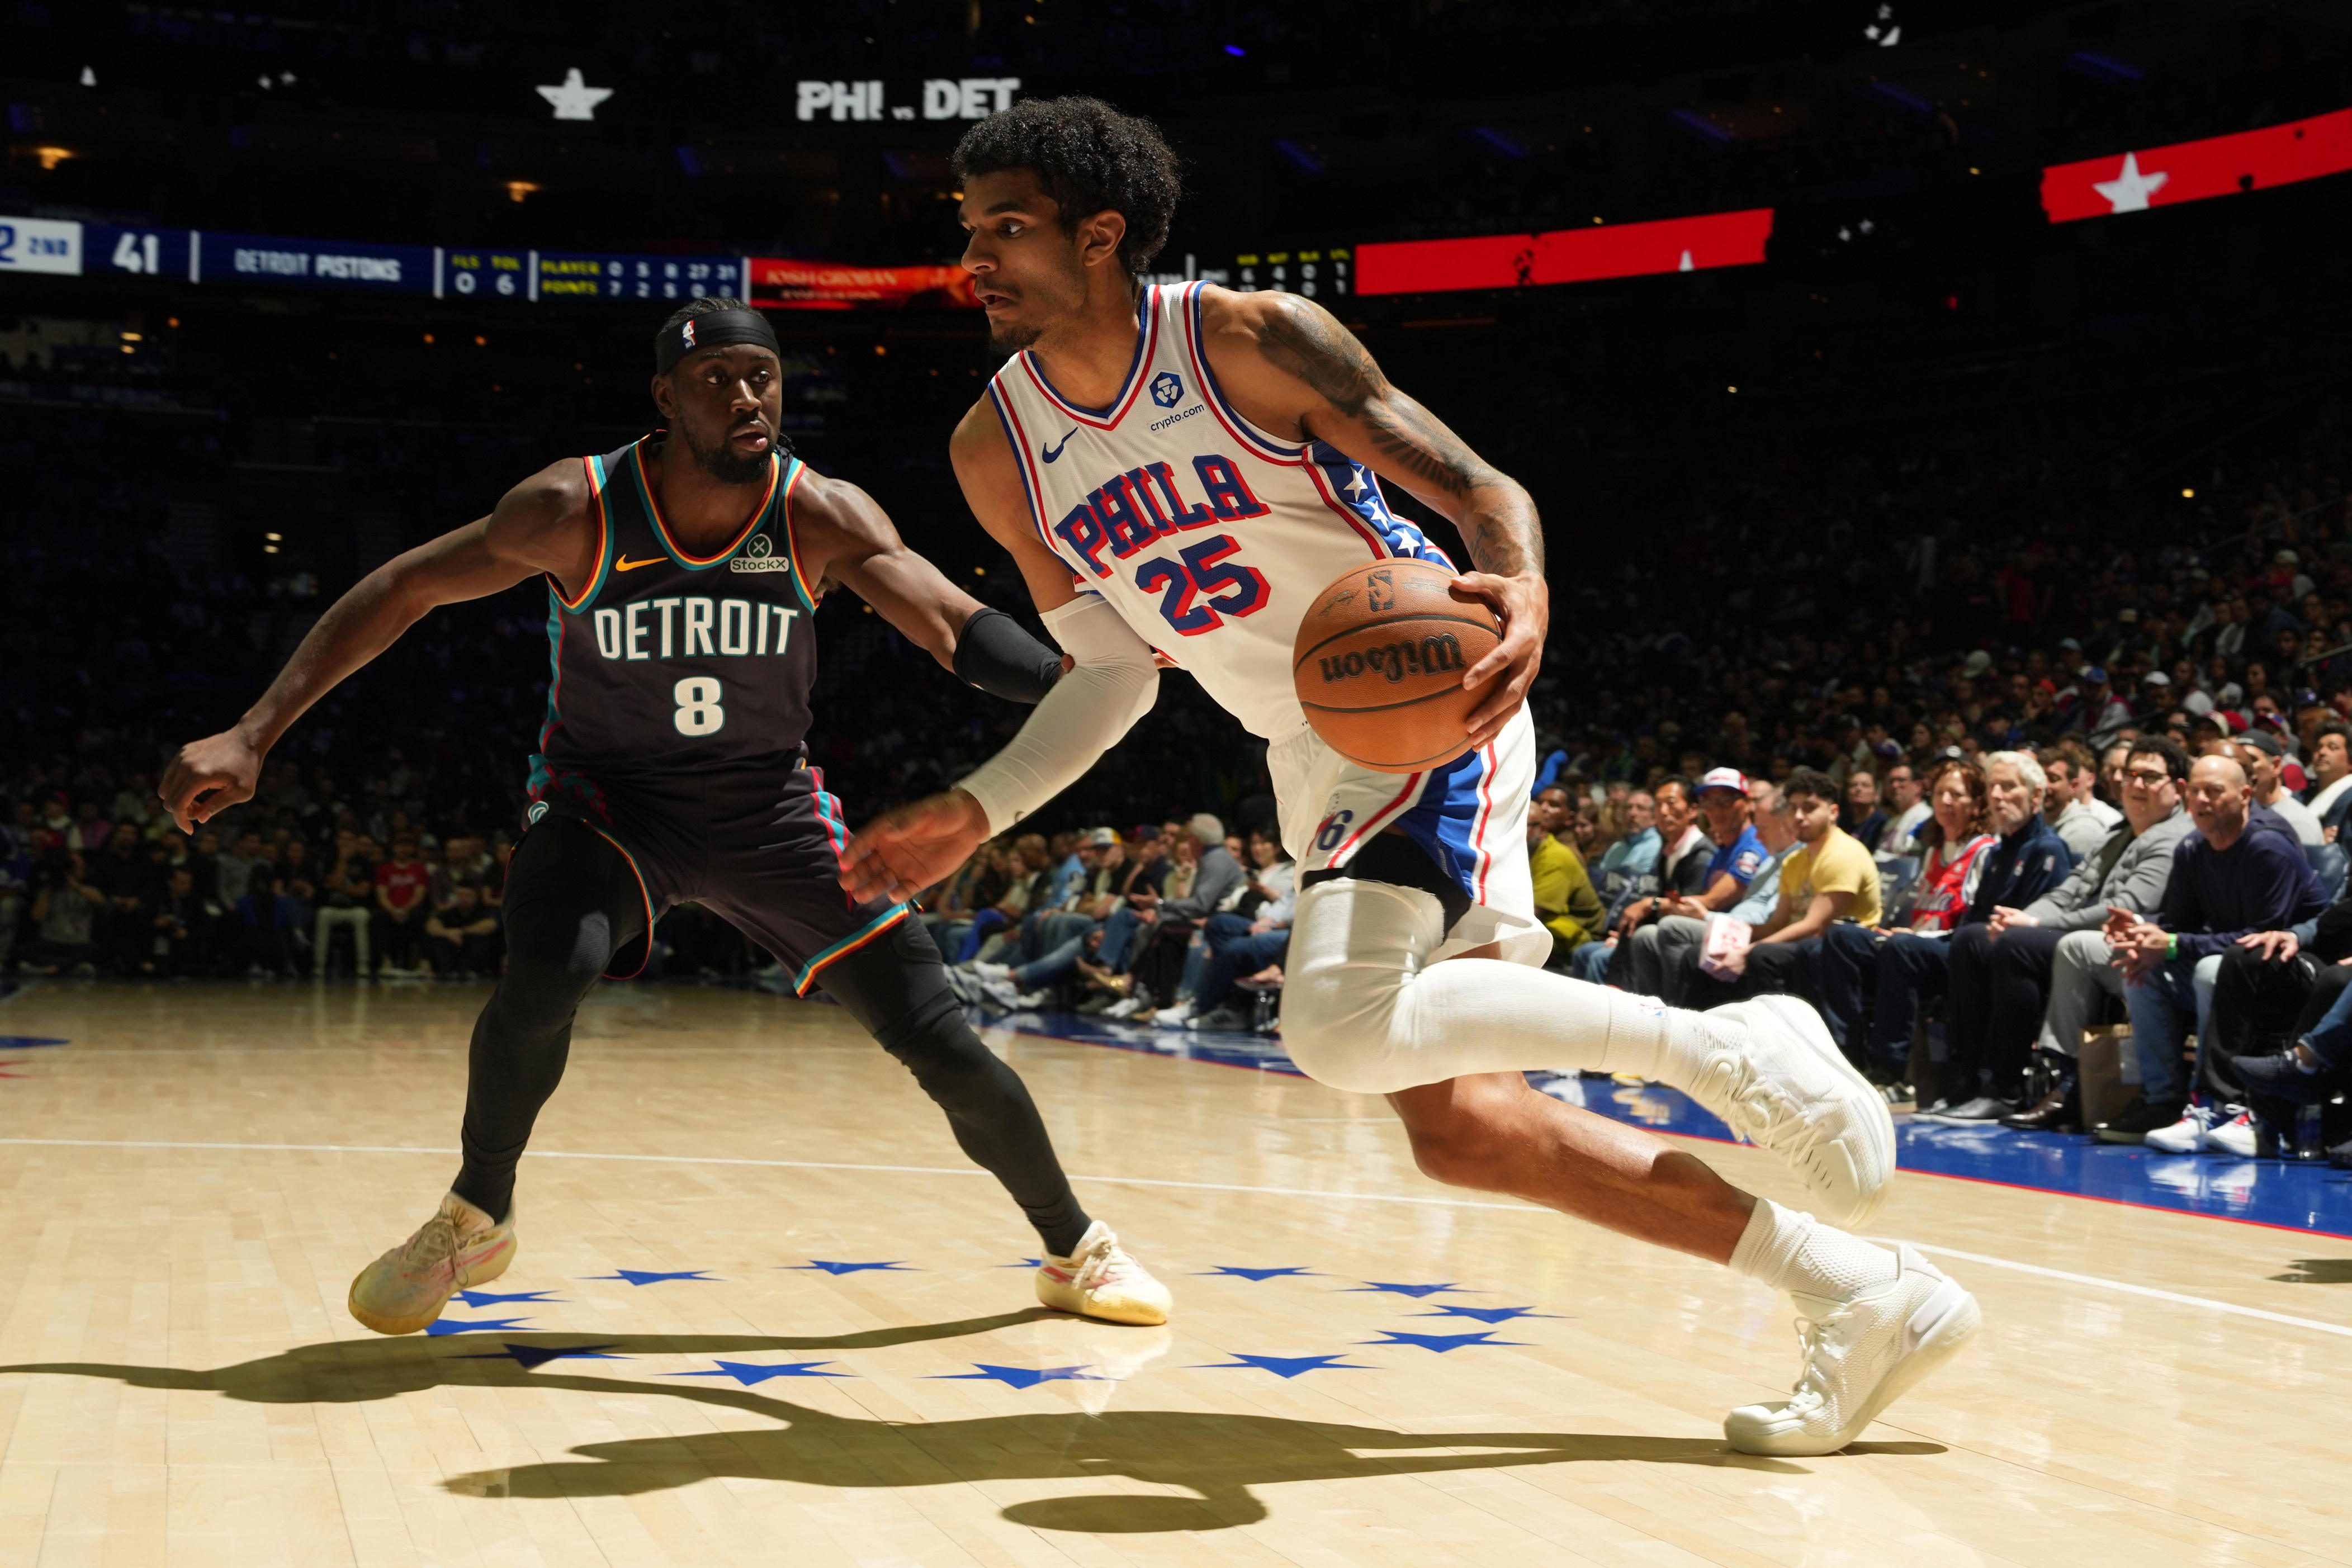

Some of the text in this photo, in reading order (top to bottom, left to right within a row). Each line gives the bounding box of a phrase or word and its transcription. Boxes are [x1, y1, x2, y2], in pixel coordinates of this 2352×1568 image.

[923, 77, 1021, 120] DET
[113, 232, 159, 274] 41
[234, 248, 401, 282] DETROIT PISTONS
[455, 271, 515, 296] 0 6
[1151, 404, 1204, 431] crypto.com
[1054, 454, 1272, 579] PHILA
[732, 559, 785, 570] StockX
[1135, 534, 1271, 636] 25
[594, 596, 799, 661] DETROIT
[1318, 633, 1466, 683] Wilson
[673, 676, 725, 737] 8
